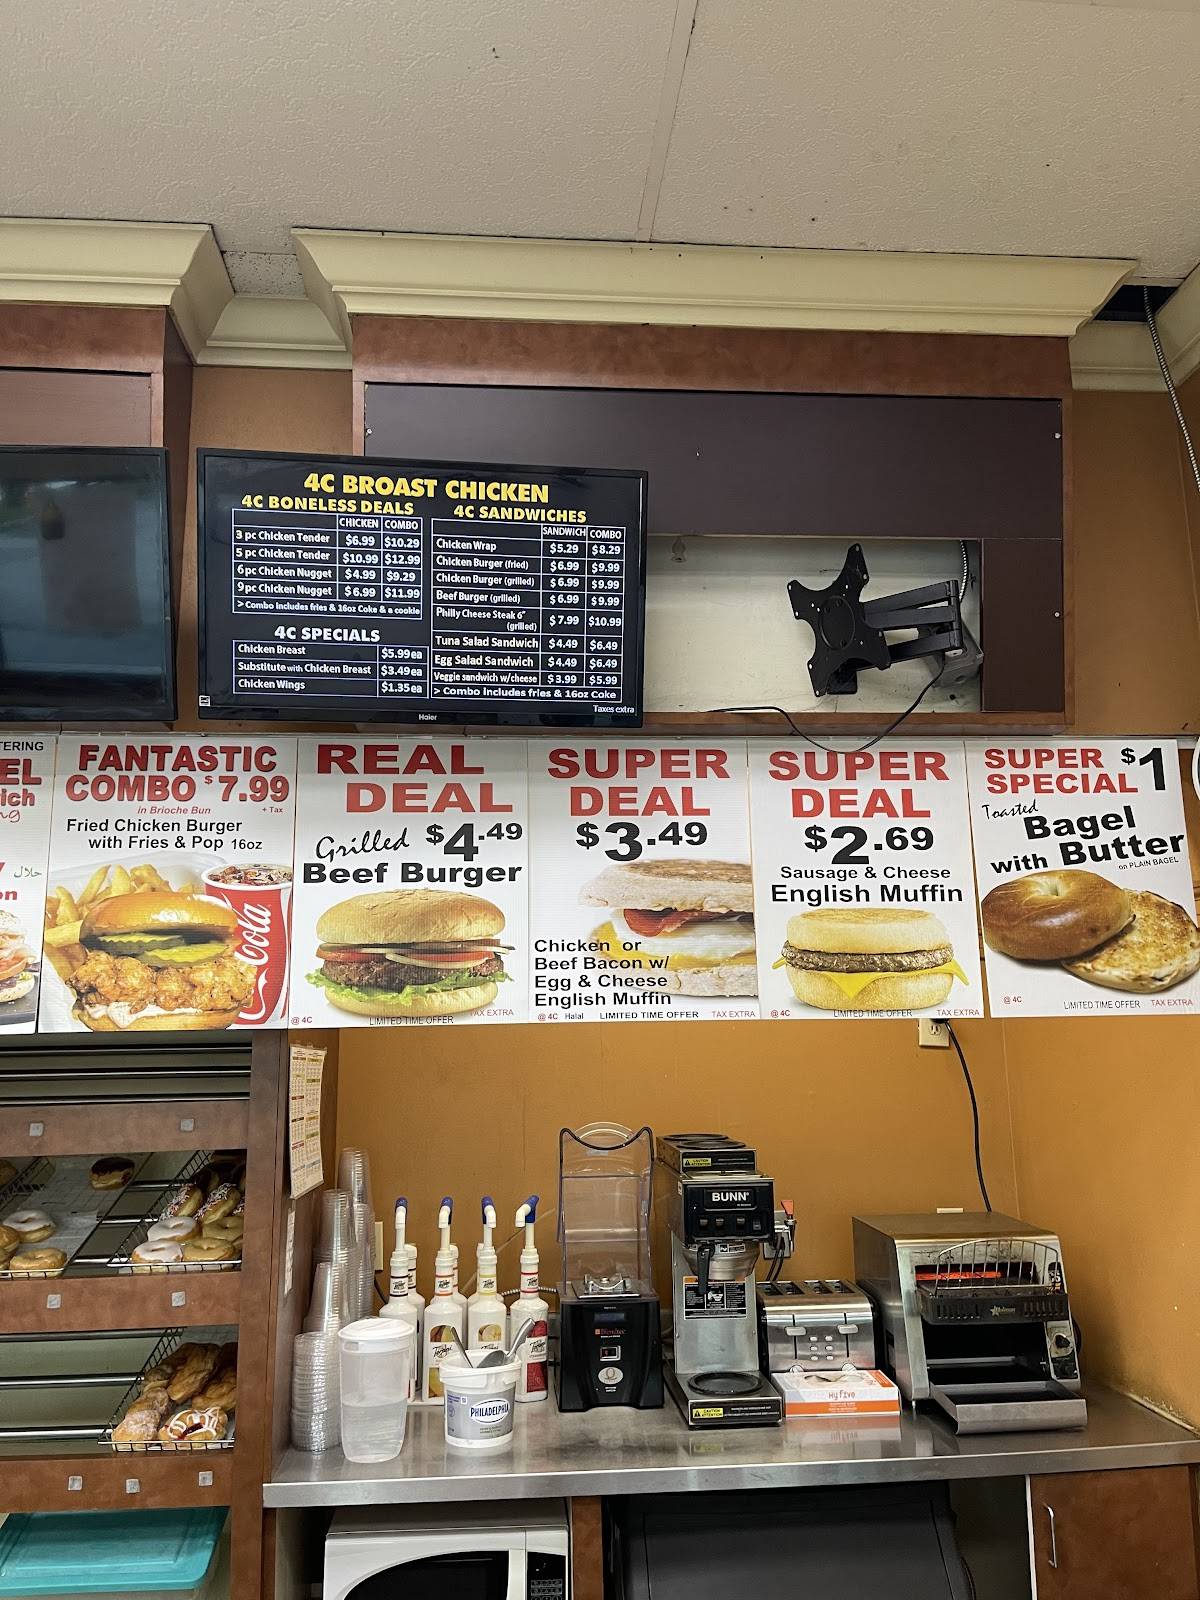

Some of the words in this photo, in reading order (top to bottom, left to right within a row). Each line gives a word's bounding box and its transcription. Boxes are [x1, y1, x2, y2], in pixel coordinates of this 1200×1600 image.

[304, 473, 335, 493] 4C
[343, 475, 437, 498] BROAST
[445, 480, 549, 503] CHICKEN
[241, 495, 263, 508] 4C
[268, 496, 356, 513] BONELESS
[361, 501, 414, 515] DEALS
[454, 505, 475, 518] 4C
[479, 506, 587, 523] SANDWICHES
[339, 518, 378, 528] CHICKEN
[385, 520, 418, 530] COMBO
[259, 531, 295, 542] Chicken
[297, 533, 330, 543] Tender
[346, 534, 375, 546] $6.99
[384, 537, 420, 548] $10.29
[543, 527, 586, 537] SANDWICH
[589, 530, 621, 539] COMBO
[436, 538, 472, 549] Chicken
[473, 541, 496, 553] Wrap
[550, 543, 579, 554] $5.29
[592, 544, 621, 555] $8.29
[259, 548, 295, 559] Chicken
[297, 550, 330, 561] Tender
[343, 552, 378, 564] $10.99
[385, 554, 420, 565] $12.99
[436, 555, 472, 566] Chicken
[474, 558, 503, 570] Burger
[505, 560, 529, 570] (fried)
[550, 561, 579, 572] $6.99
[592, 562, 620, 573] $9.99
[259, 565, 295, 577] Chicken
[297, 567, 332, 579] Nugget
[345, 569, 376, 580] $4.99
[386, 570, 415, 582] $9.29
[436, 573, 471, 584] Chicken
[473, 574, 502, 587] Burger
[504, 577, 534, 587] (grilled)
[550, 578, 579, 588] $6.99
[592, 579, 620, 590] $9.99
[259, 582, 295, 594] Chicken
[297, 584, 332, 596] Nugget
[345, 586, 376, 597] $6.99
[384, 587, 420, 598] $11.99
[437, 590, 457, 601] Beef
[458, 592, 488, 603] Burger
[490, 594, 520, 604] (grilled)
[550, 594, 579, 605] $6.99
[591, 596, 620, 606] $9.99
[436, 607, 461, 619] Philly
[462, 608, 491, 619] Cheese
[493, 610, 515, 620] Steak
[507, 622, 537, 632] (grilled)
[550, 615, 579, 627] $7.99
[589, 616, 622, 627] $10.99
[274, 626, 296, 640] 4C
[302, 628, 381, 642] SPECIALS
[238, 644, 275, 654] Chicken
[277, 645, 306, 655] Breast
[435, 636, 460, 646] Tuna
[462, 637, 490, 647] Salad
[491, 637, 538, 649] Sandwich
[549, 638, 578, 649] $4.49
[590, 640, 618, 651] $6.49
[238, 662, 286, 672] Substitute
[304, 663, 341, 674] Chicken
[343, 664, 371, 675] Breast
[435, 655, 453, 667] Egg
[455, 655, 483, 666] Salad
[484, 656, 534, 667] Sandwich
[548, 657, 577, 668] $4.49
[589, 658, 618, 669] $6.49
[238, 678, 275, 689] Chicken
[276, 679, 306, 691] Wings
[434, 671, 461, 682] Veggie
[461, 672, 498, 682] sandwich
[547, 674, 577, 685] $3.99
[589, 675, 617, 686] $5.99
[419, 713, 438, 721] Haier
[593, 704, 614, 713] Taxes
[78, 744, 277, 772] FANTASTIC
[317, 744, 484, 775] REAL
[547, 748, 730, 779] SUPER
[769, 751, 949, 781] SUPER
[985, 748, 1104, 769] SUPER
[1121, 747, 1166, 791] $1
[65, 775, 196, 802] COMBO
[204, 775, 289, 802] $7.99
[987, 773, 1138, 794] SPECIAL
[346, 783, 513, 813] DEAL
[570, 786, 711, 817] DEAL
[792, 788, 931, 818] DEAL
[137, 806, 147, 815] in
[150, 806, 188, 815] Brioche
[191, 807, 211, 815] Bun
[269, 806, 284, 814] Tax
[981, 799, 1039, 820] Toasted
[67, 819, 109, 832] Fried
[115, 819, 181, 832] Chicken
[187, 819, 242, 835] Burger
[1024, 805, 1136, 840] Bagel
[88, 835, 123, 849] with
[129, 836, 169, 849] Fries
[174, 836, 186, 849] &
[192, 836, 224, 851] Pop
[231, 839, 263, 850] 16oz
[315, 827, 410, 862] Grilled
[576, 821, 708, 862] $3.49
[804, 825, 934, 865] $2.69
[990, 853, 1048, 874] with
[1059, 834, 1185, 866] Butter
[1129, 860, 1152, 869] PLAIN
[303, 862, 388, 884] Beef
[401, 862, 522, 888] Burger
[780, 866, 858, 881] Sausage
[864, 866, 877, 879] &
[883, 866, 951, 879] Cheese
[771, 884, 870, 907] English
[880, 884, 963, 902] Muffin
[534, 939, 610, 952] Chicken
[622, 941, 642, 951] or
[535, 957, 577, 970] Beef
[584, 956, 643, 970] Bacon
[650, 956, 669, 969] w/
[535, 975, 571, 991] Egg
[578, 974, 592, 988] &
[598, 974, 668, 987] Cheese
[535, 992, 606, 1009] English
[613, 992, 672, 1006] Muffin
[1063, 1000, 1093, 1010] LIMITED
[1095, 1000, 1114, 1009] TIME
[1114, 1000, 1141, 1009] OFFER
[564, 1012, 584, 1020] Halal
[600, 1011, 638, 1020] LIMITED
[641, 1011, 664, 1019] TIME
[667, 1010, 699, 1019] OFFER
[712, 1010, 727, 1018] TAX
[729, 1010, 756, 1018] EXTRA
[954, 1008, 980, 1016] EXTRA
